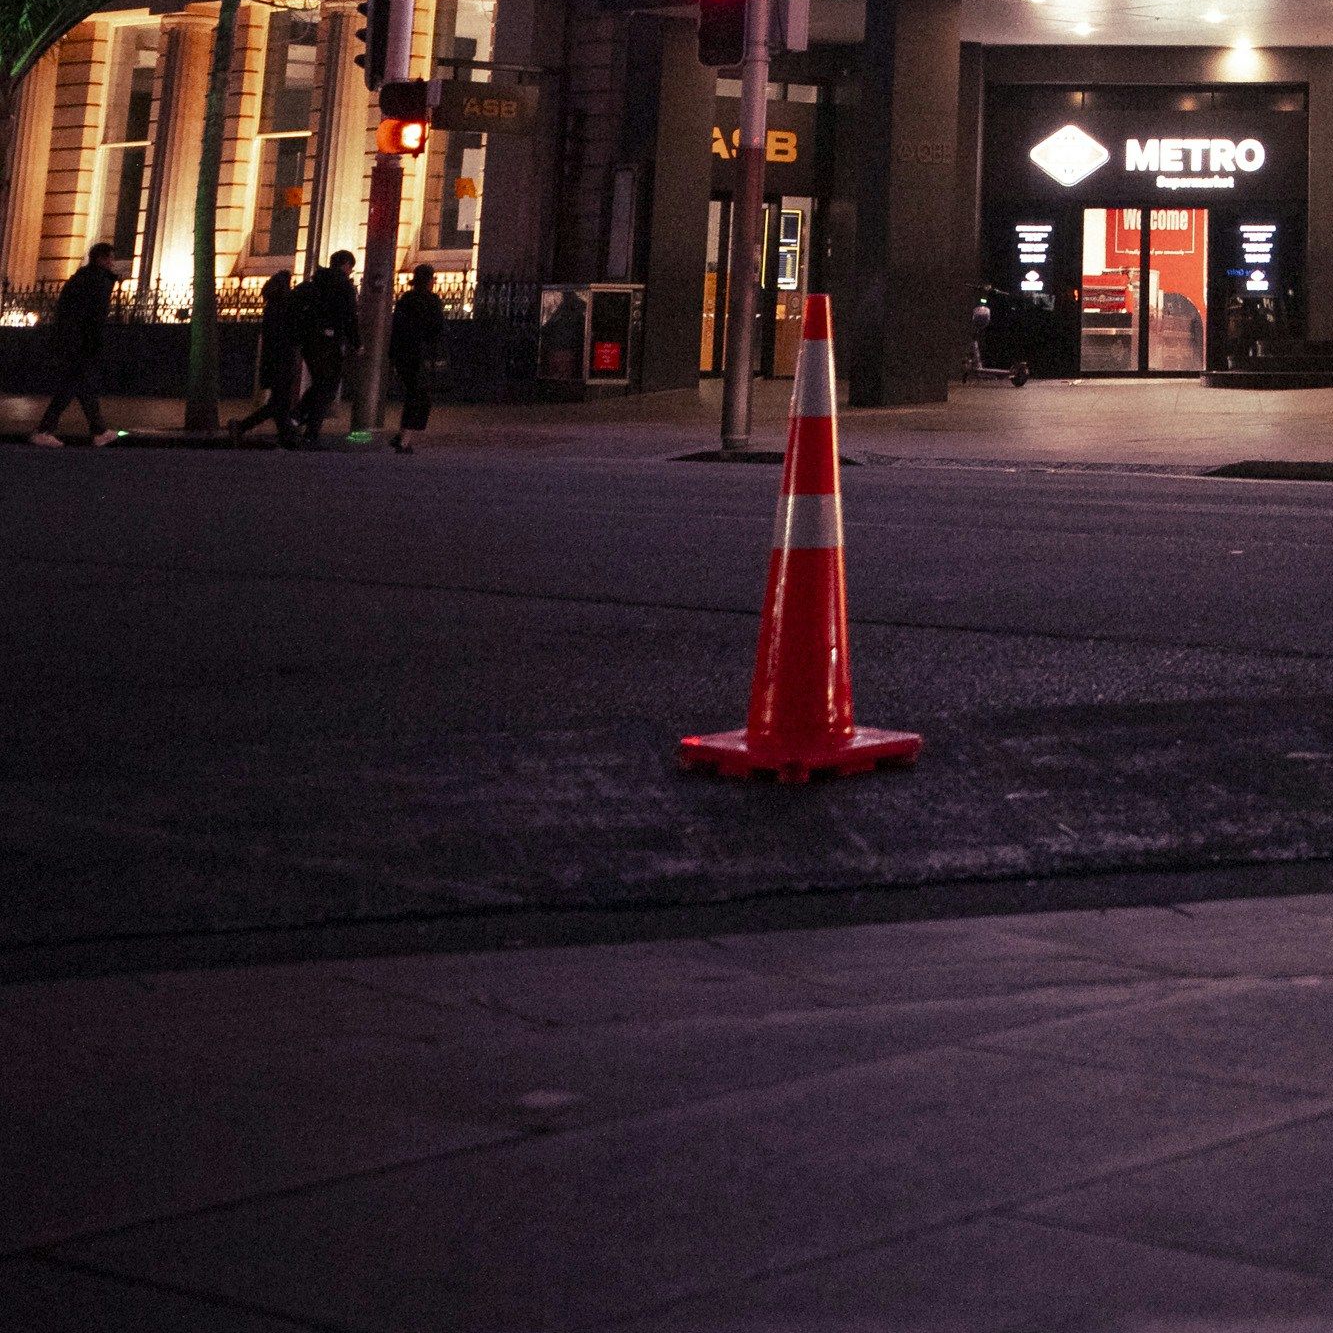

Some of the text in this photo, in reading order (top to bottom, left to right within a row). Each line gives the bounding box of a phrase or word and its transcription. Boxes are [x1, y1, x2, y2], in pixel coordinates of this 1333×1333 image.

[463, 97, 518, 118] ASB
[1125, 138, 1266, 172] METRO
[1156, 174, 1235, 190] Supermarket
[1122, 208, 1189, 231] Wecome
